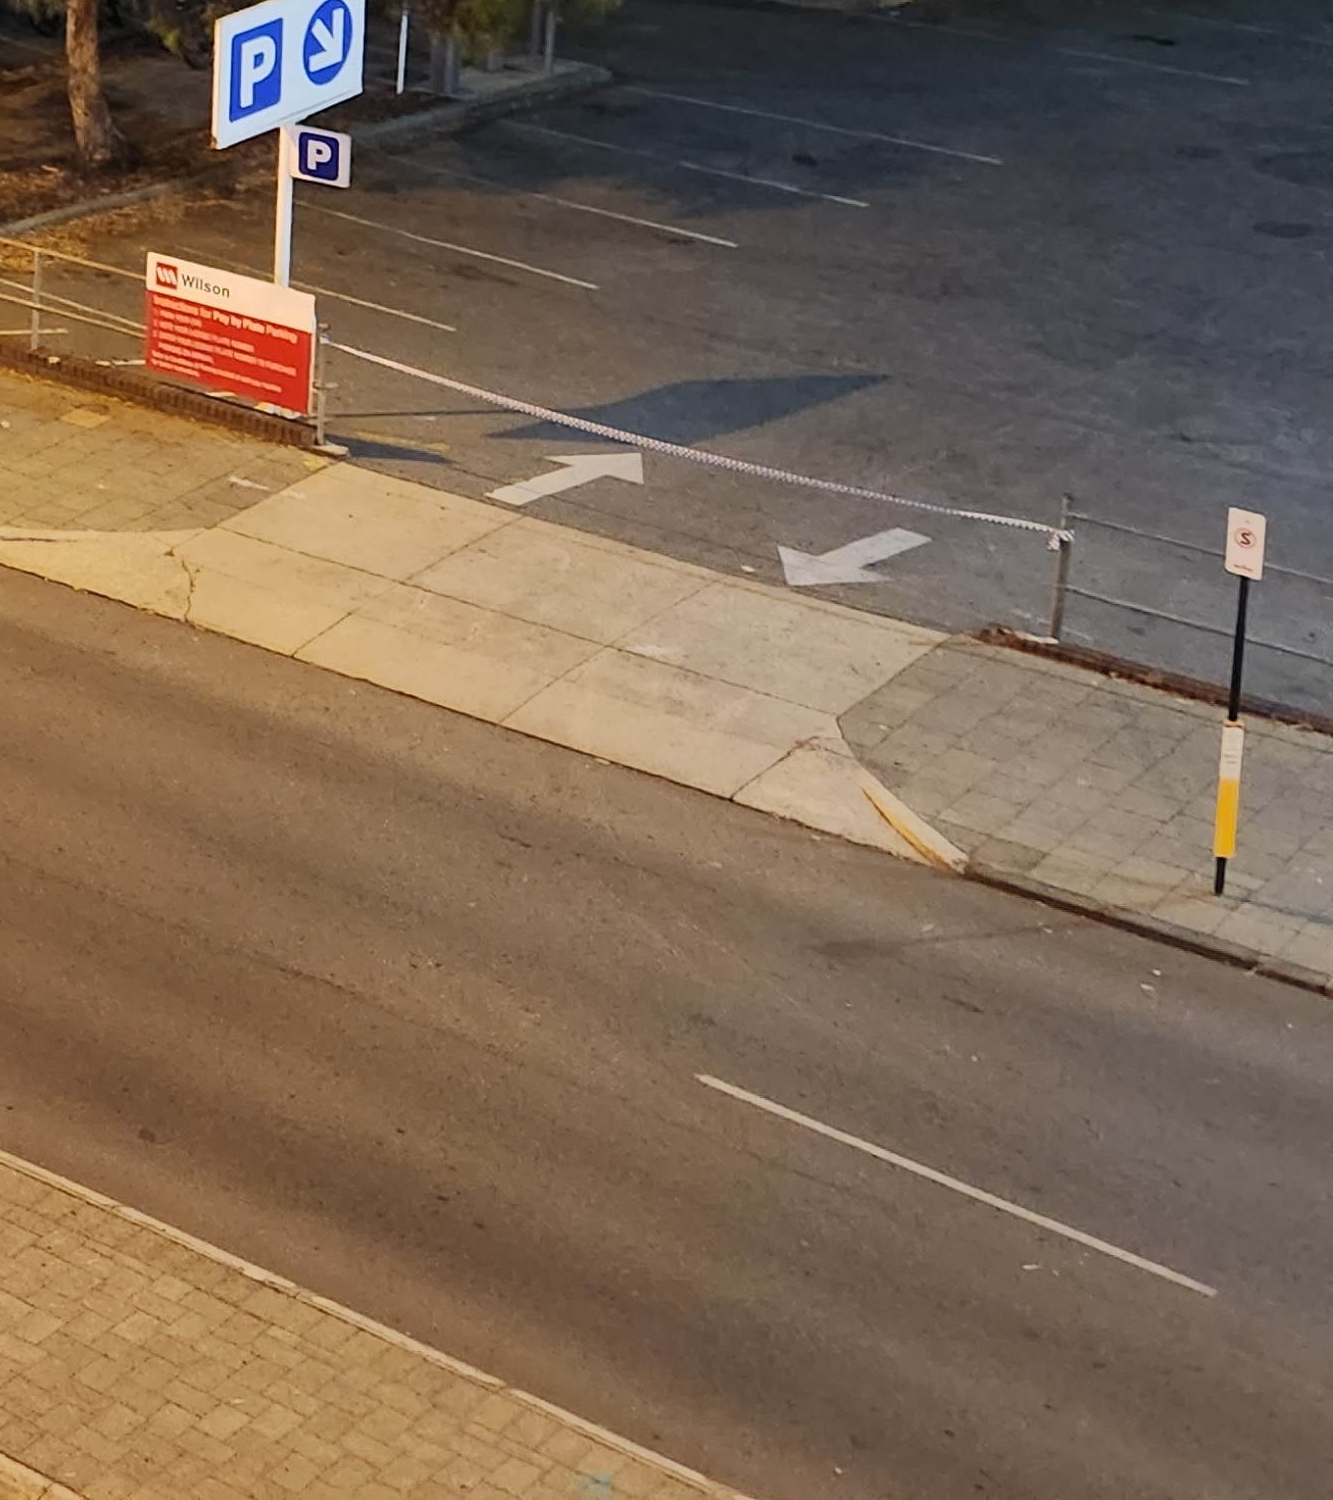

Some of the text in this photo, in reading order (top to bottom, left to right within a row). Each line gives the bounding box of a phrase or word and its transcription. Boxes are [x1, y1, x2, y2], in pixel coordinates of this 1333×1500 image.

[240, 35, 276, 109] P
[307, 139, 332, 171] P
[181, 273, 231, 298] Wilson
